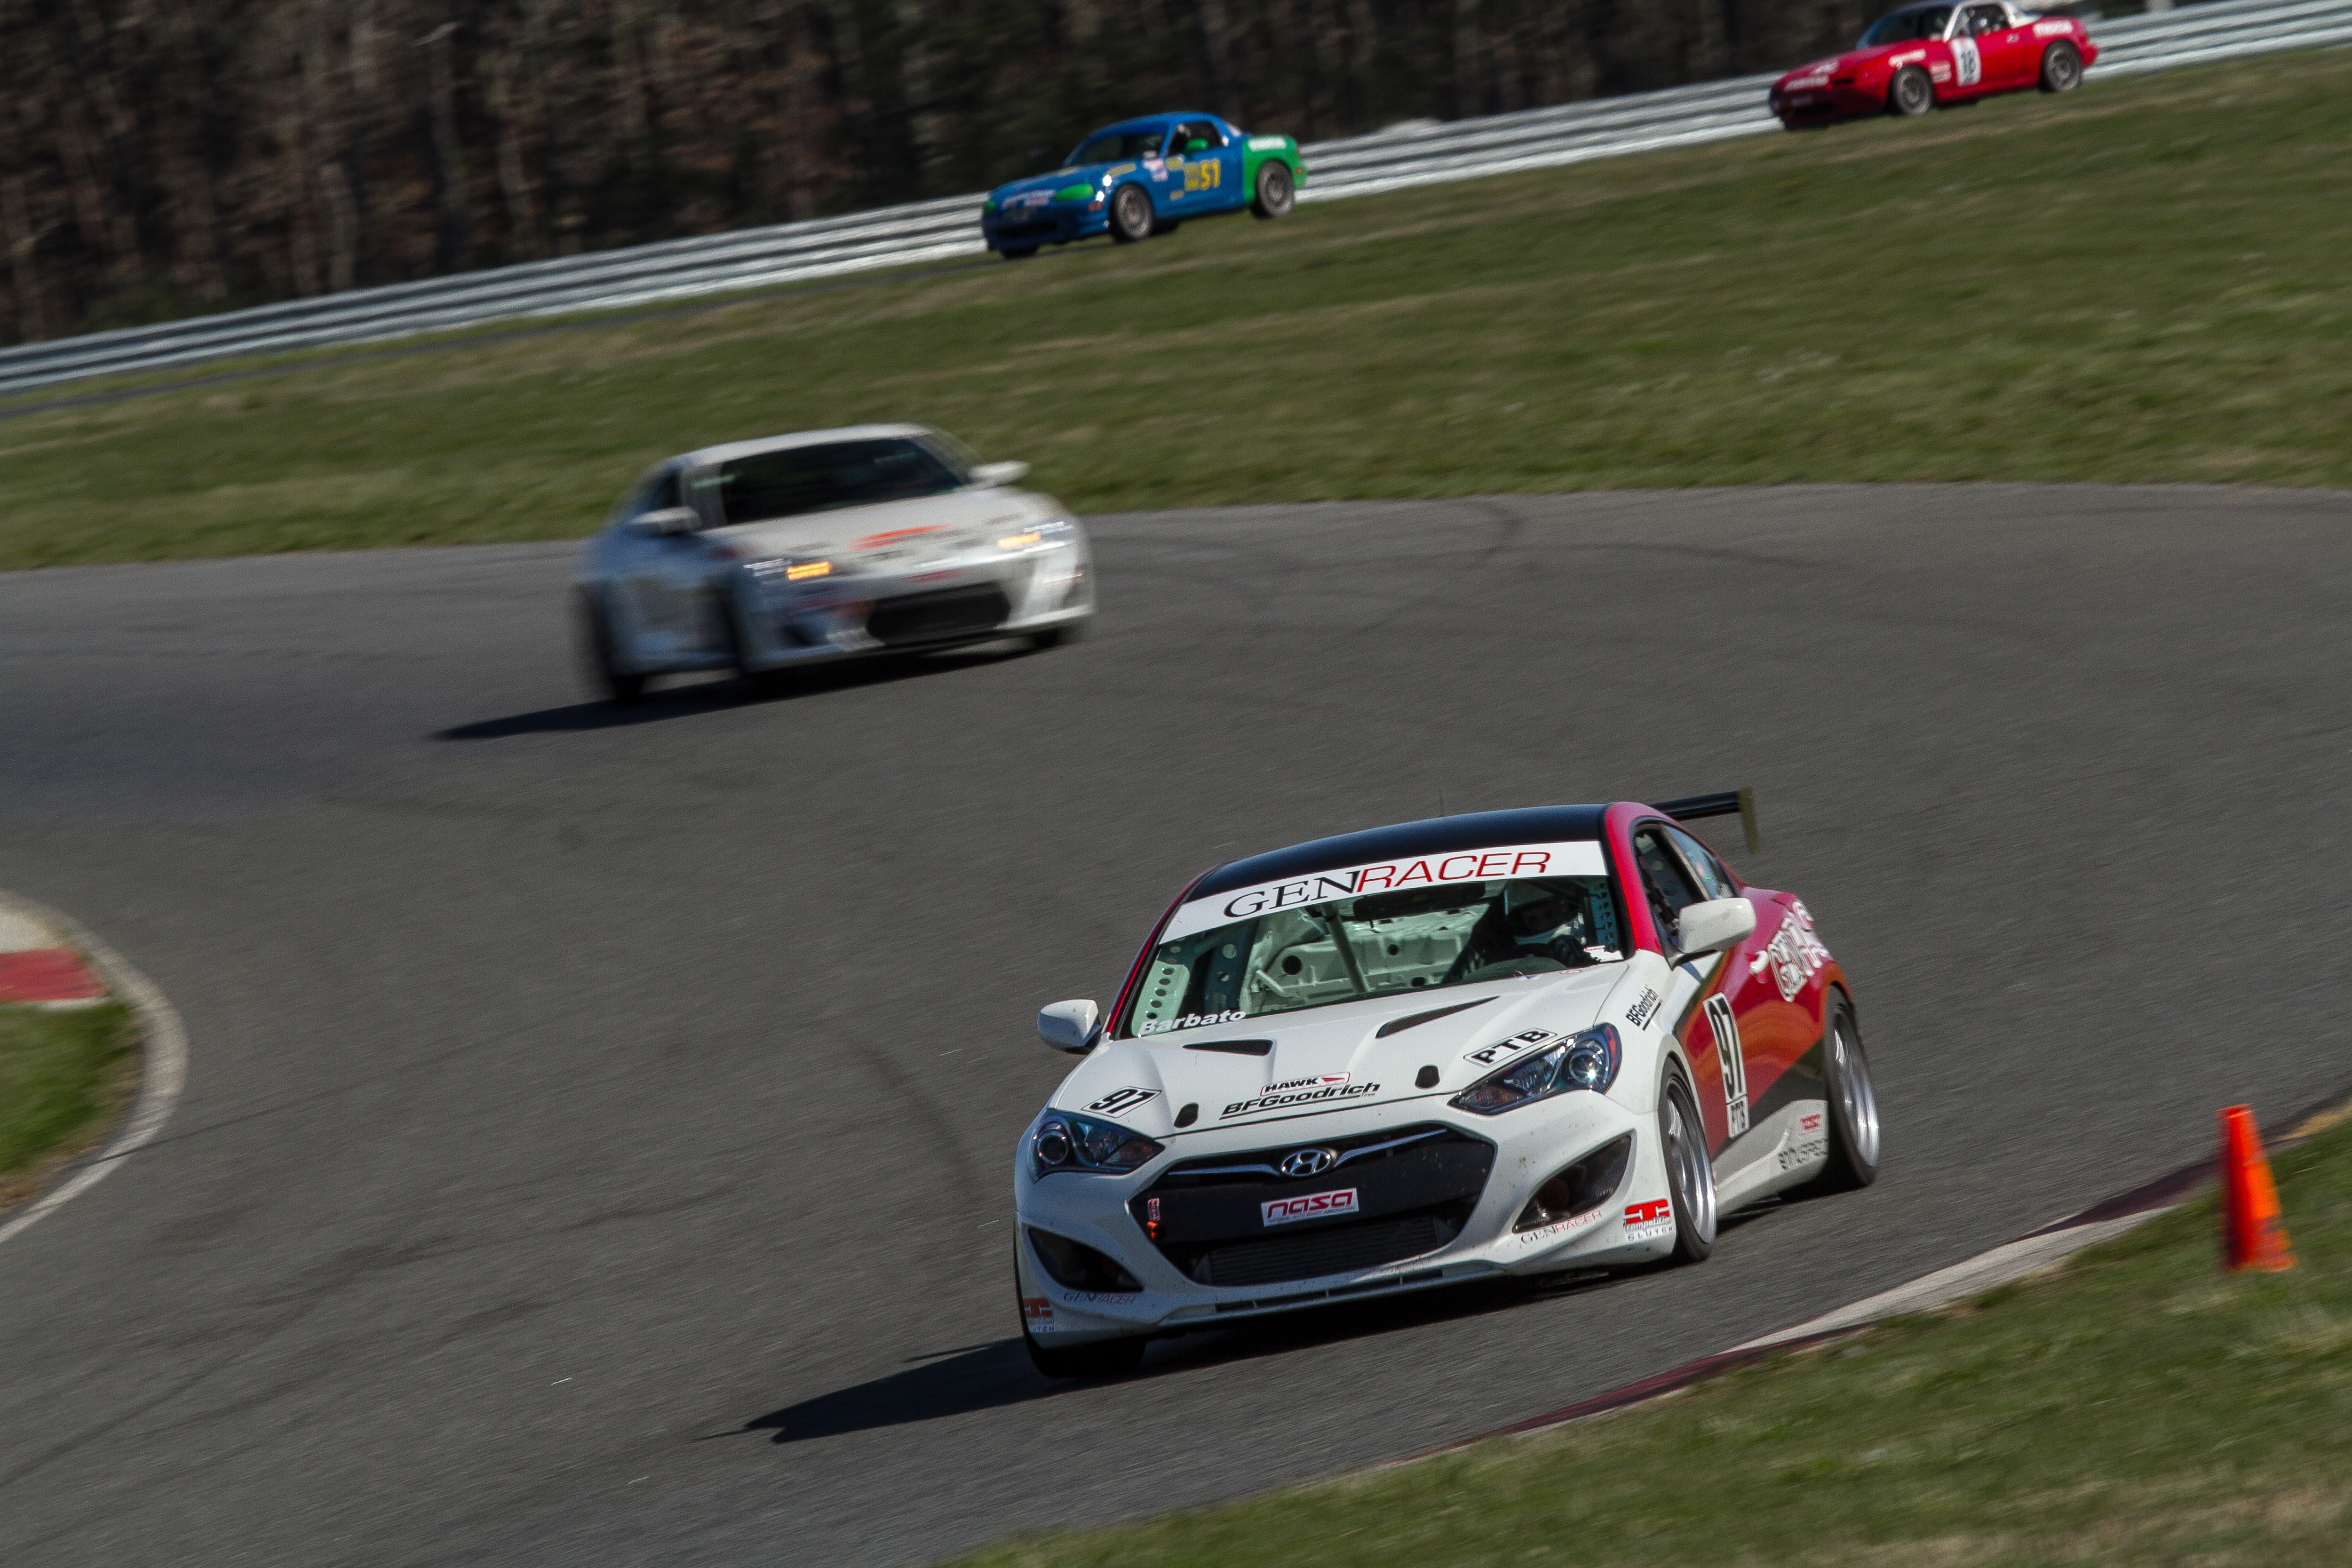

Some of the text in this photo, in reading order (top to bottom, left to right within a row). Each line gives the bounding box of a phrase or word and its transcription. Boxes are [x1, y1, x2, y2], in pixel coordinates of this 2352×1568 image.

[1200, 159, 1220, 189] 51
[1224, 852, 1550, 918] GENRACER
[1138, 1009, 1246, 1035] Barbato
[1625, 984, 1659, 1027] BFGoodrich
[1471, 1030, 1549, 1064] PTB
[1708, 997, 1742, 1099] 97
[1089, 1089, 1157, 1114] 97
[1221, 1082, 1381, 1115] BFGoodrich
[1264, 1078, 1319, 1092] HAWK
[1521, 1210, 1603, 1243] GENRACER
[1064, 1293, 1136, 1305] GENRACER
